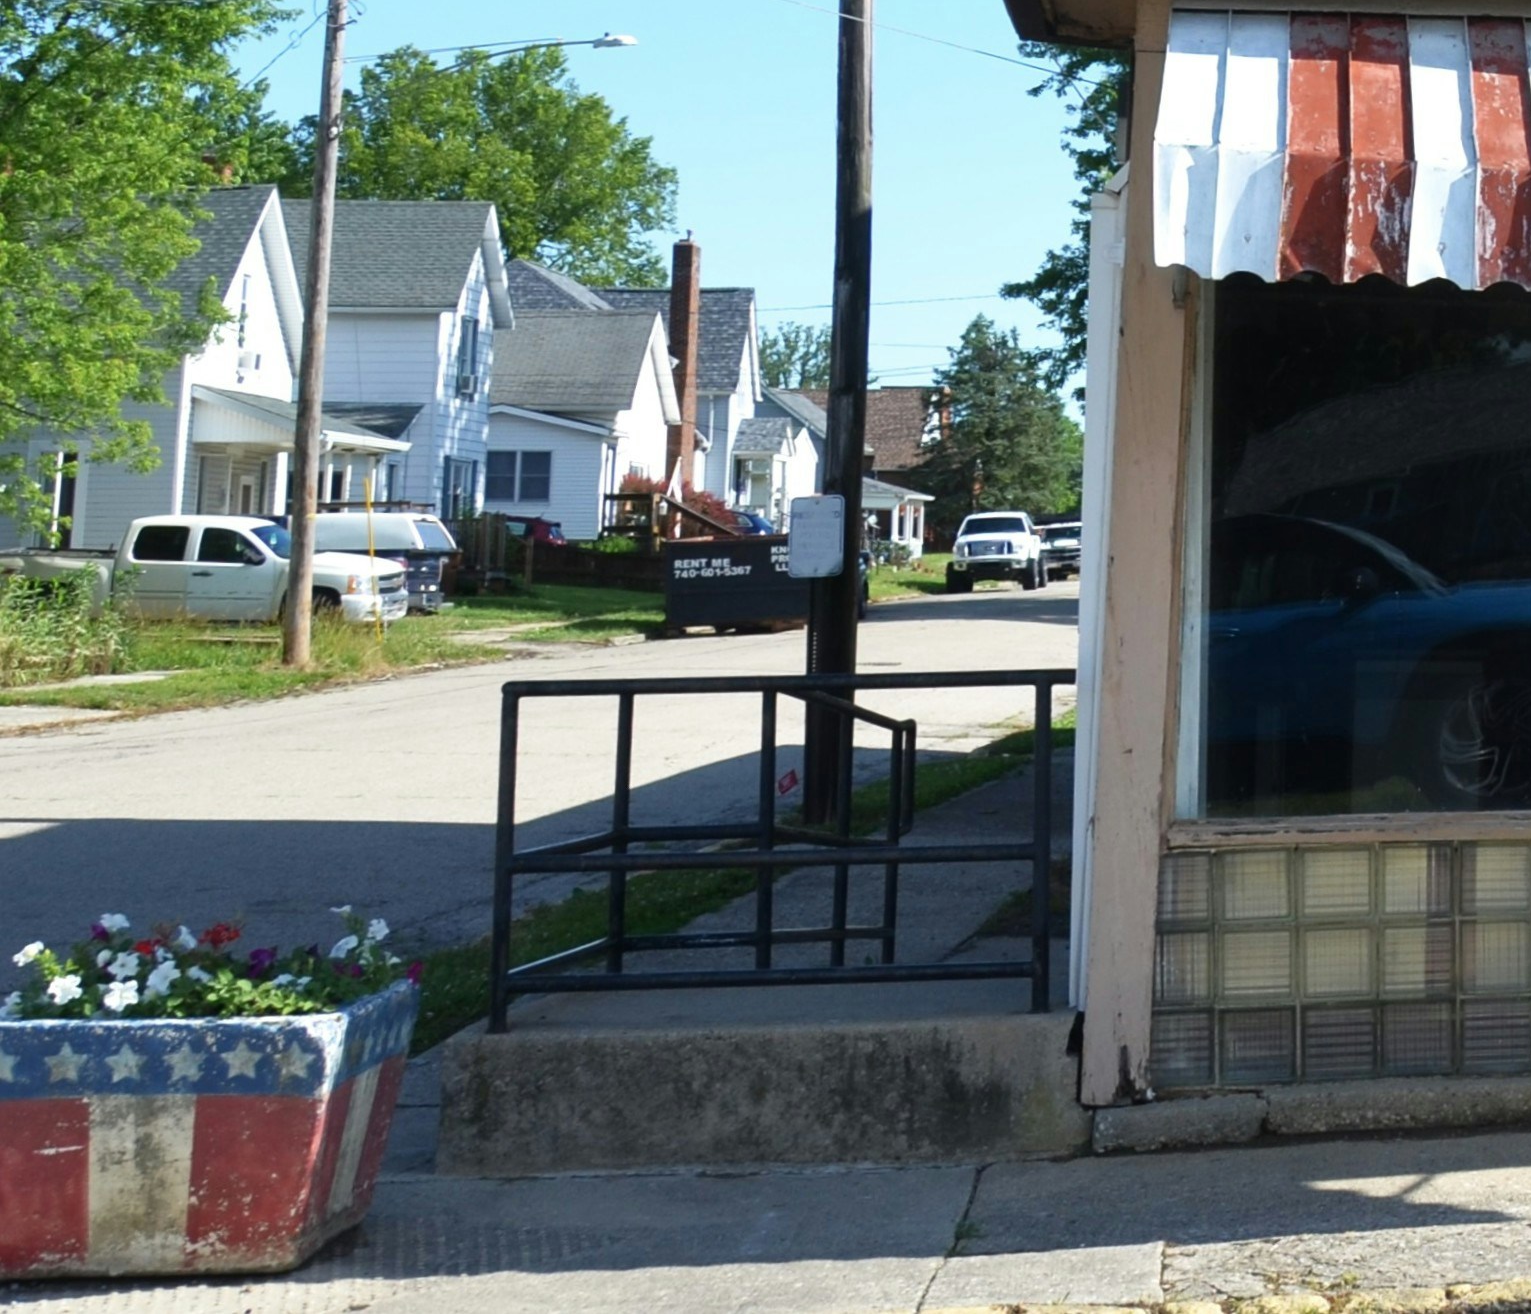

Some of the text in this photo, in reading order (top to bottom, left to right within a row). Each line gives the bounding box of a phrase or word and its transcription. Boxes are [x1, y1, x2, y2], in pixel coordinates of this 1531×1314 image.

[771, 546, 790, 554] KN
[674, 558, 731, 568] RENT ME
